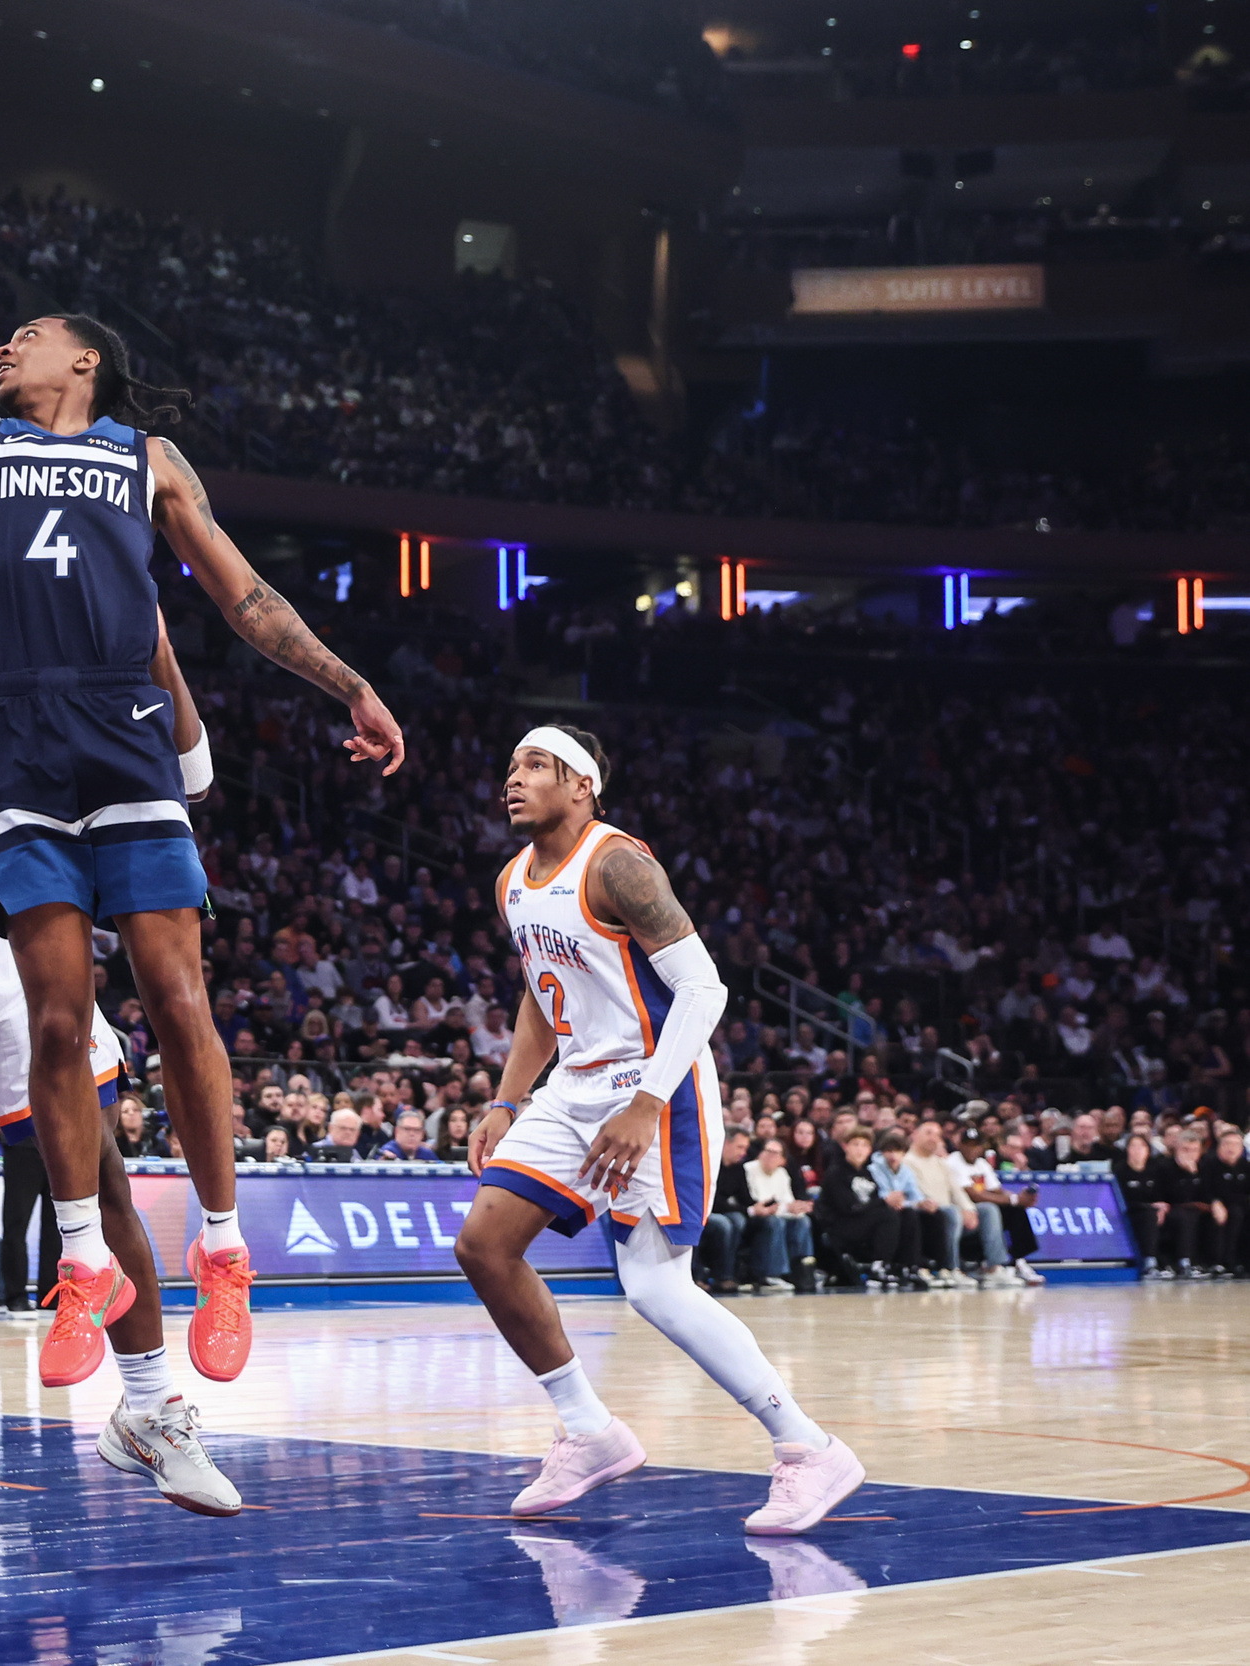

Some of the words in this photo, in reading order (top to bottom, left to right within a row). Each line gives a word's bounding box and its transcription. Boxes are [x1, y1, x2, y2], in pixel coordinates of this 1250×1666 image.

[961, 273, 1032, 299] LEVEL
[23, 507, 79, 578] 4
[530, 924, 592, 974] YORK
[538, 972, 573, 1036] 2
[611, 1069, 642, 1090] NYC
[1026, 1207, 1115, 1236] DELTA
